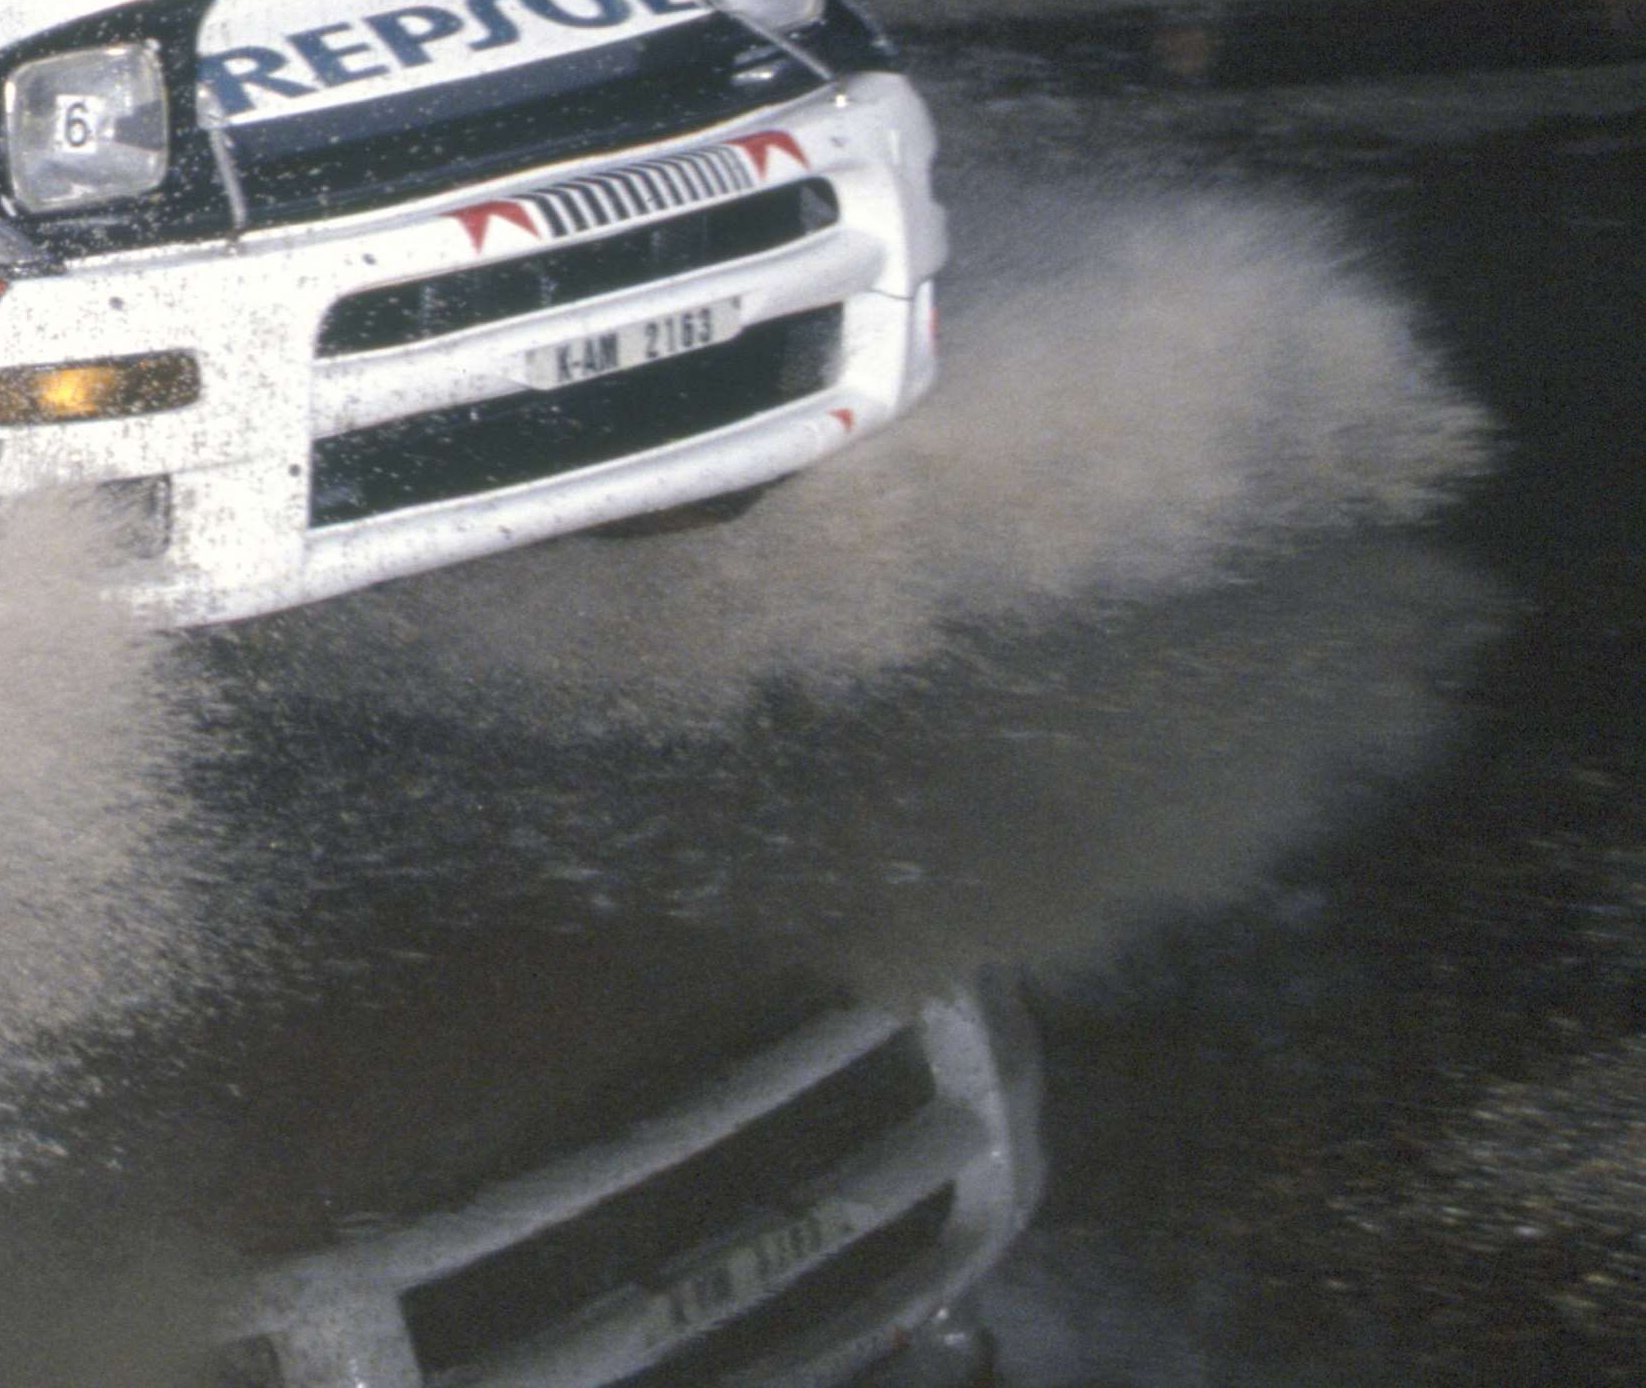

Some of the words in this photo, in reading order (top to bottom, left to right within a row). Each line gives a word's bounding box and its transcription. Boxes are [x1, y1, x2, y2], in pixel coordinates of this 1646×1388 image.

[64, 100, 93, 148] 6
[556, 330, 621, 382] K-AM
[644, 309, 714, 360] 2163
